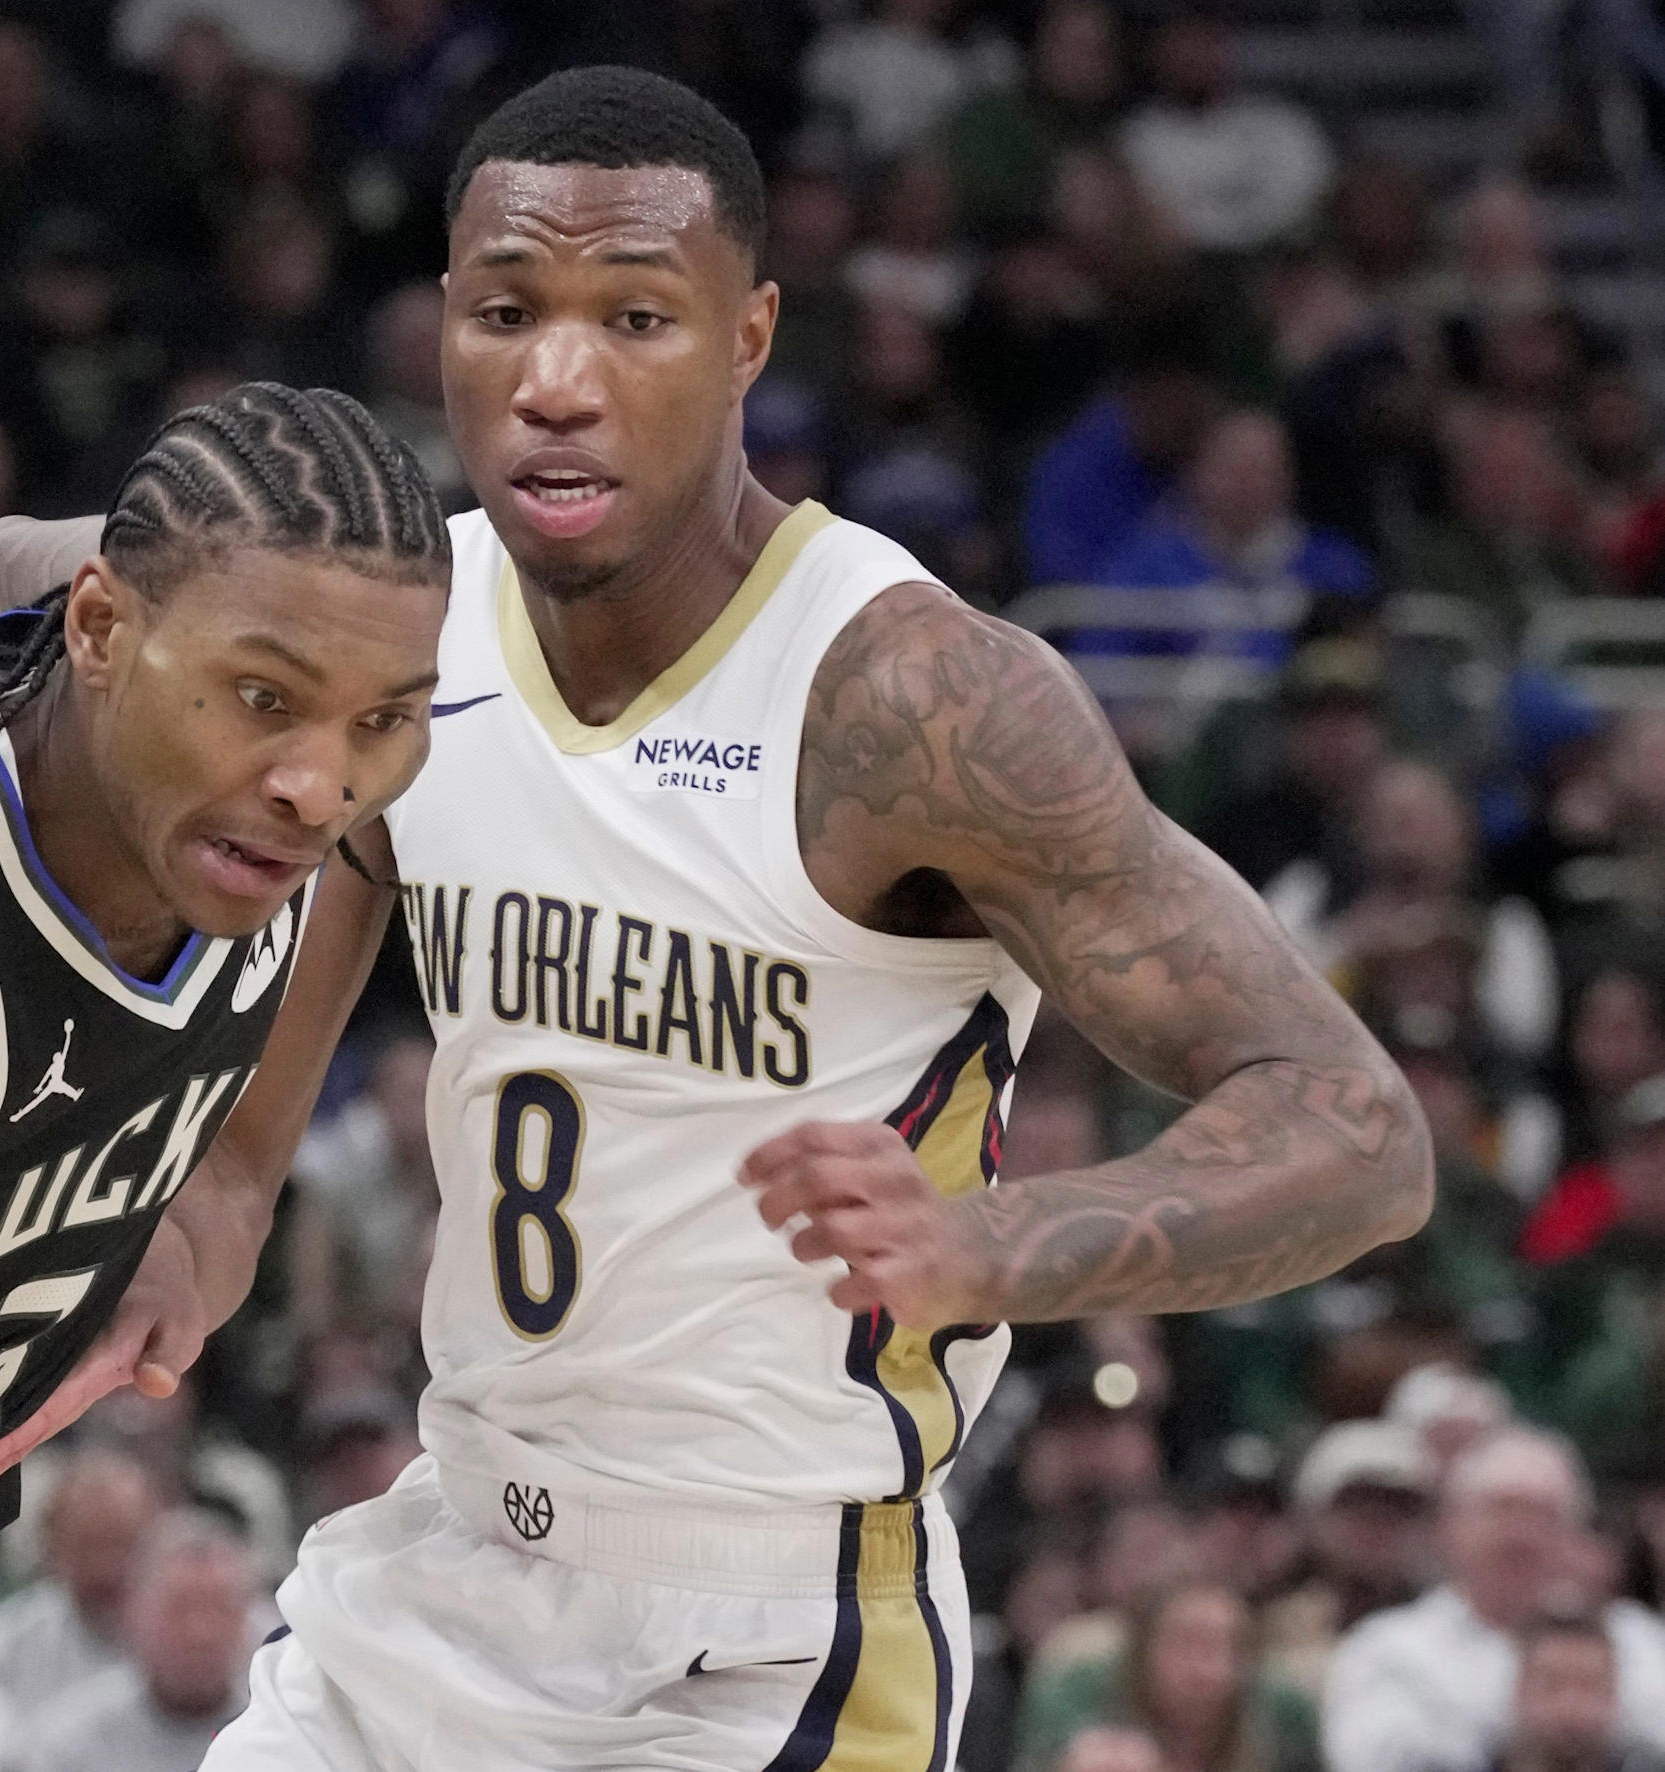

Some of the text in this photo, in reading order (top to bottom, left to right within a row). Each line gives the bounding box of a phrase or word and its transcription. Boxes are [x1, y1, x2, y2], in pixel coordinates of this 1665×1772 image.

[635, 737, 762, 771] NEWAGE
[657, 772, 727, 793] GRILLS
[490, 888, 813, 1089] ORLEANS
[489, 1067, 587, 1344] 8
